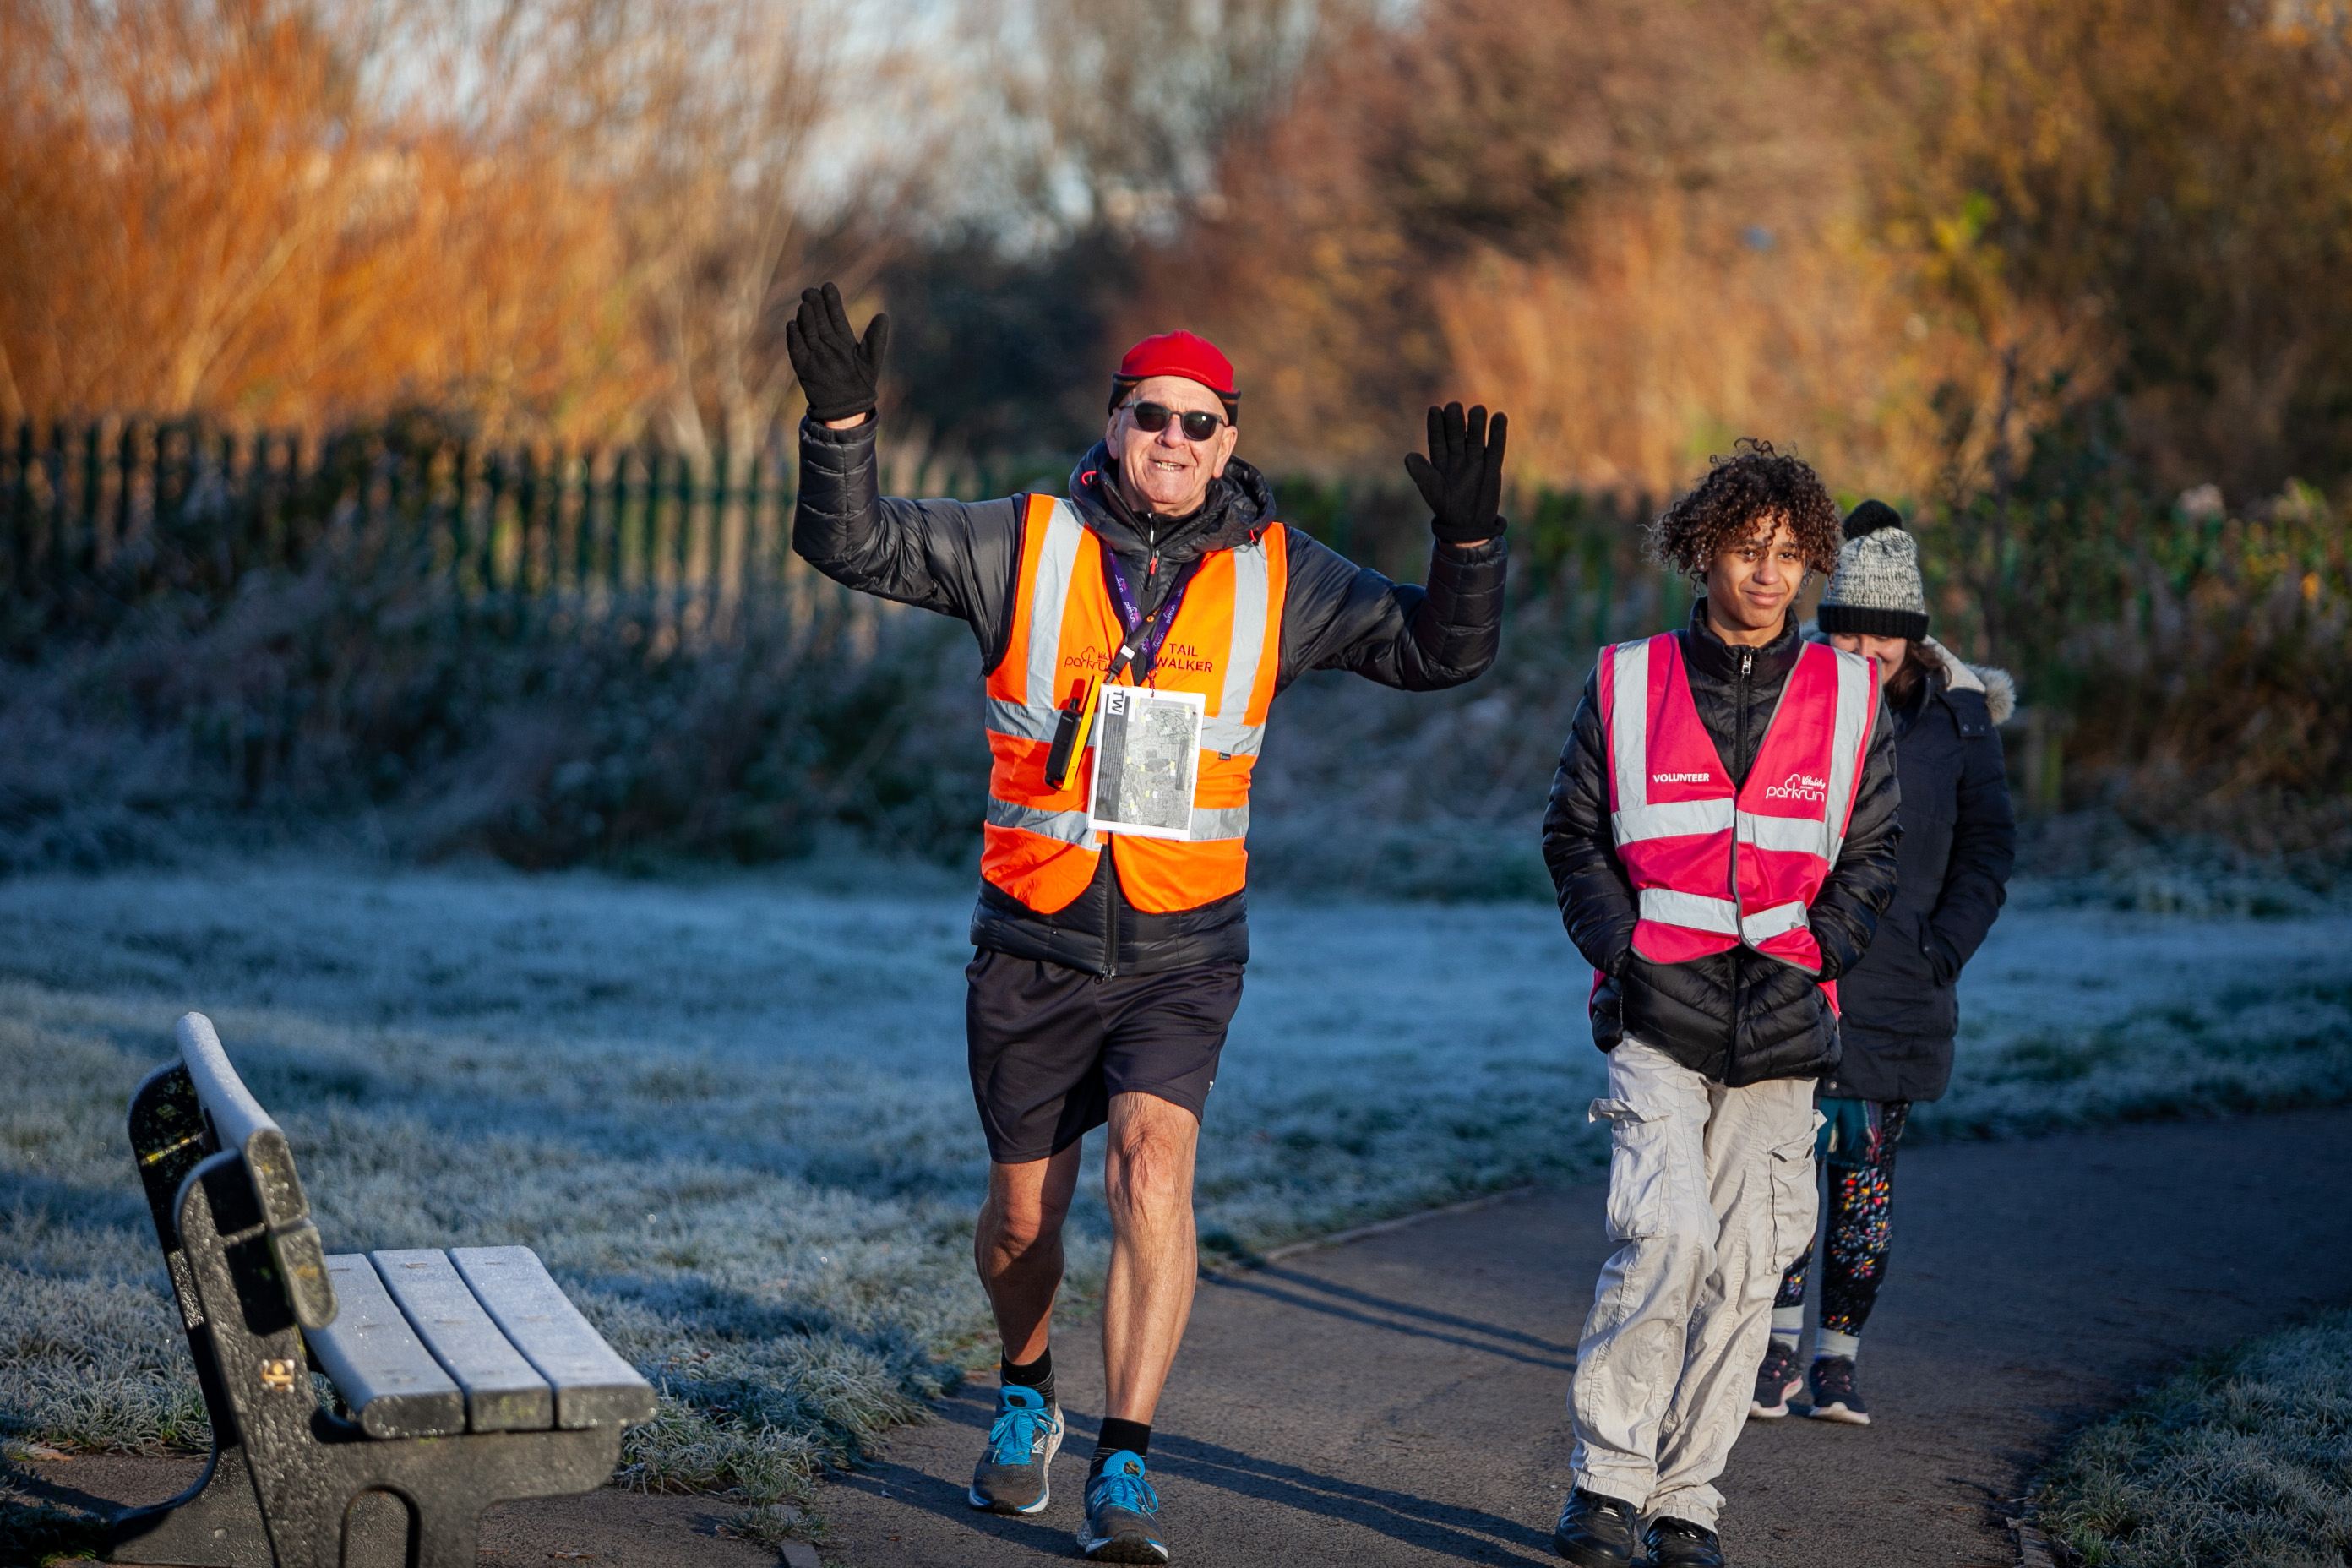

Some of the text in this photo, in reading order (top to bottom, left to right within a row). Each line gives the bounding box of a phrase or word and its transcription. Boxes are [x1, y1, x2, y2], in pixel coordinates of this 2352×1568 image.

[1168, 643, 1199, 657] TAIL
[1064, 653, 1108, 672] parkru
[1156, 656, 1213, 672] WALKER
[1112, 689, 1124, 713] TW
[1652, 772, 1710, 783] VOLUNTEER
[1801, 775, 1826, 790] Vitality
[1765, 781, 1825, 802] parkrun
